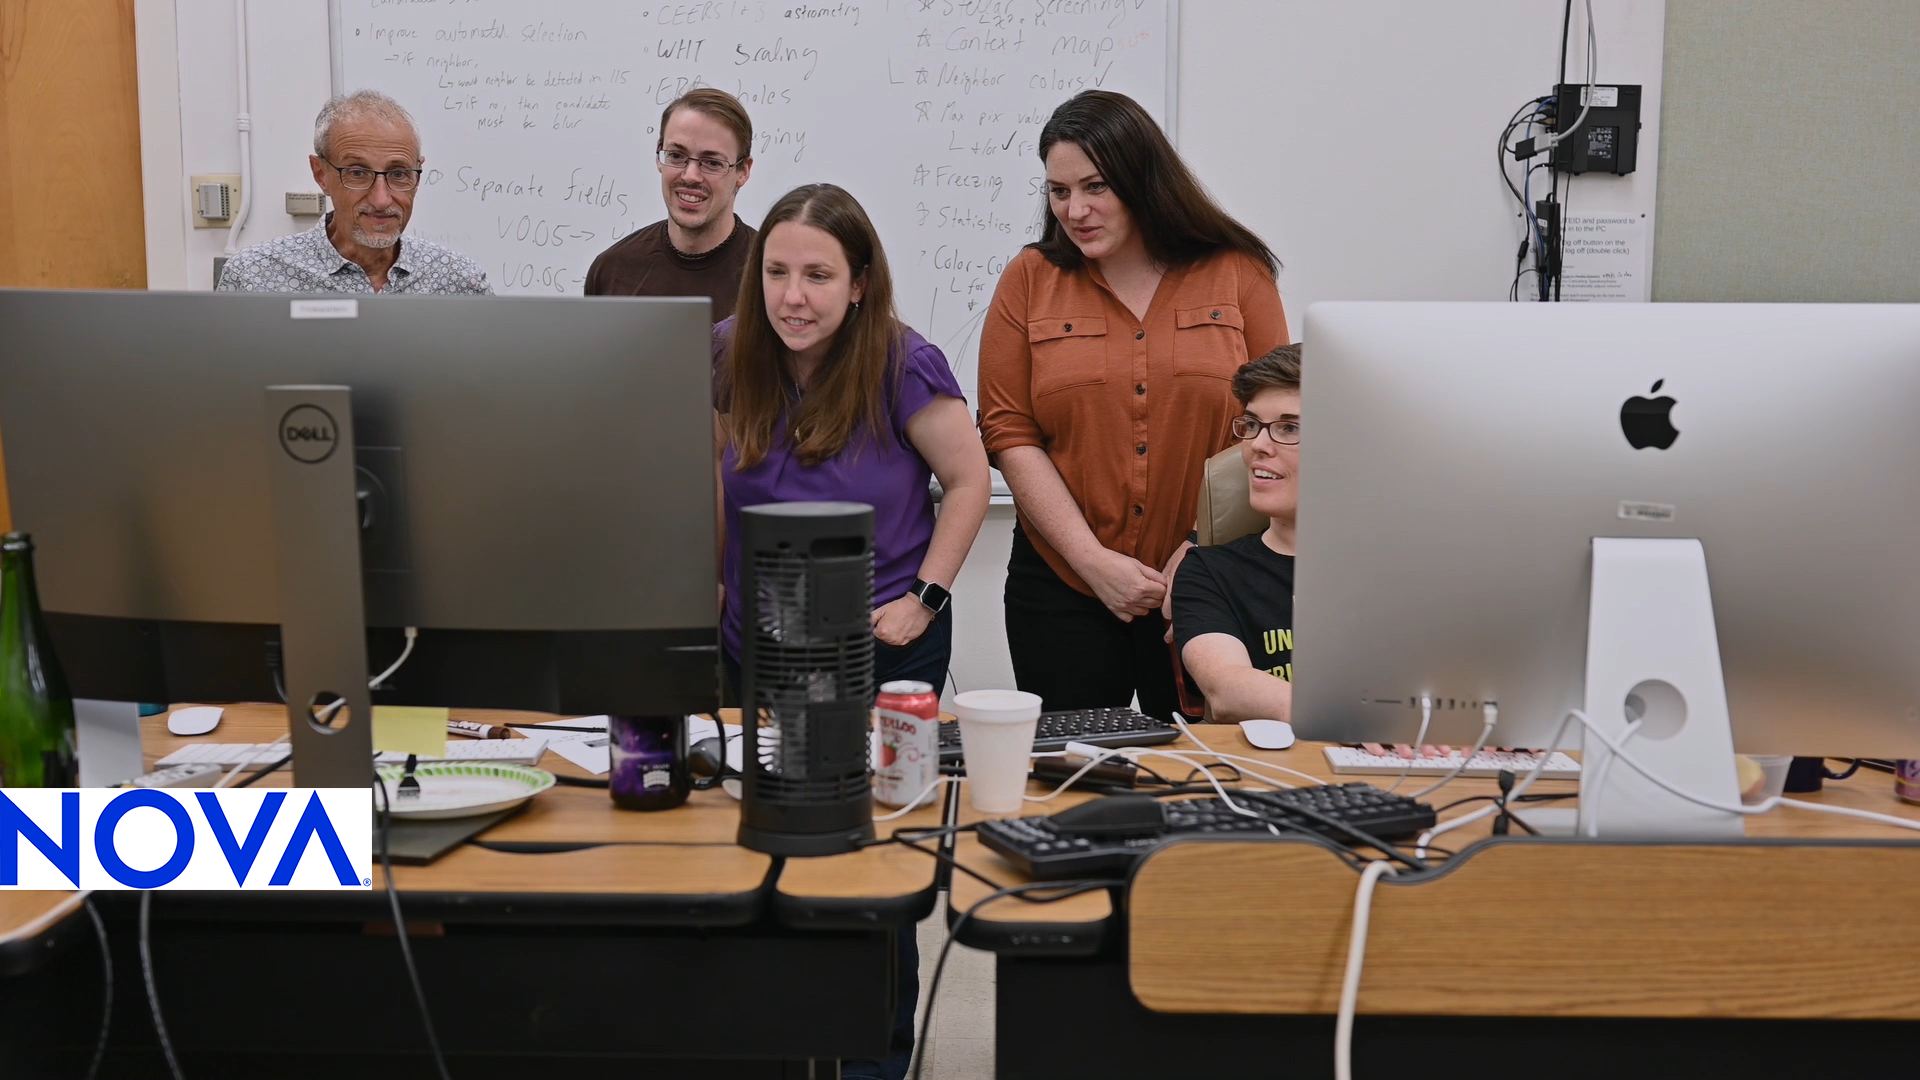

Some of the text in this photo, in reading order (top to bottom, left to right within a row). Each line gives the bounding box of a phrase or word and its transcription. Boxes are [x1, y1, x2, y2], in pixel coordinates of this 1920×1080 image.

[657, 38, 707, 63] WHT
[455, 165, 545, 202] Separate
[937, 205, 1013, 235] Statistics
[286, 426, 333, 442] DELL
